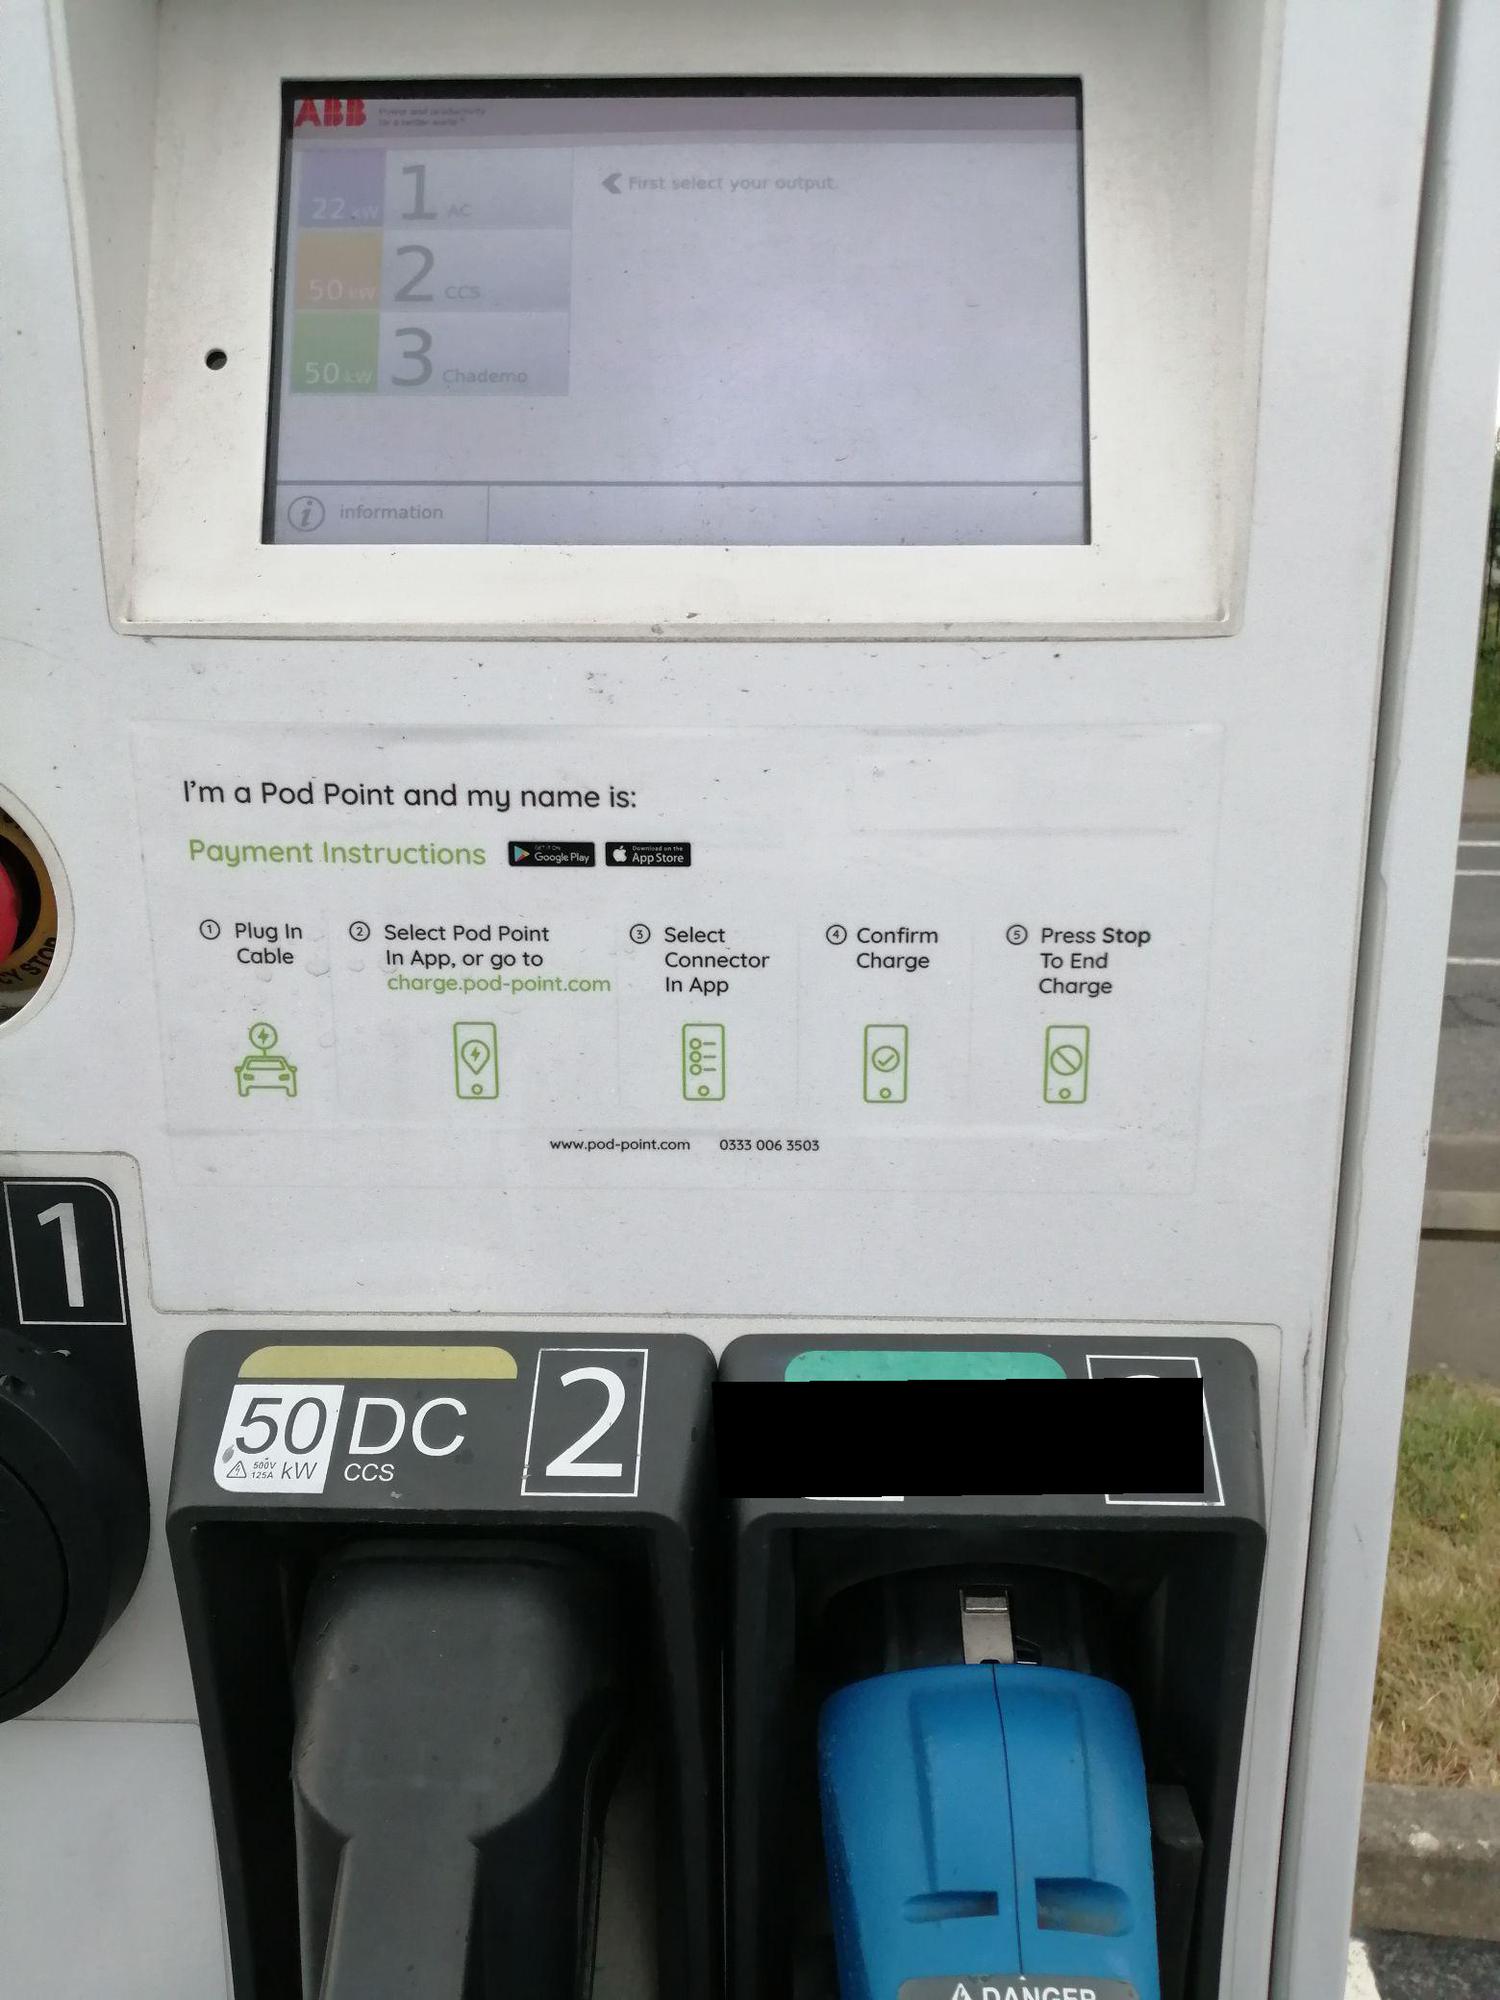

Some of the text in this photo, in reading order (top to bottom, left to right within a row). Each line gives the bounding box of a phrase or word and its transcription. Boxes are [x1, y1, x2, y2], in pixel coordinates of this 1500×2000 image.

[294, 97, 367, 127] ABB
[401, 164, 438, 222] 1
[628, 175, 666, 191] First
[672, 175, 723, 192] select
[729, 178, 768, 194] your
[311, 196, 346, 220] 22
[447, 203, 472, 218] AC
[394, 244, 435, 302] 2
[309, 279, 344, 301] 50
[444, 285, 481, 300] CCS
[391, 327, 433, 387] 3
[305, 361, 340, 385] 50
[442, 367, 528, 385] Chademo
[339, 503, 444, 521] information
[233, 786, 253, 805] a
[260, 781, 315, 806] Pod
[322, 781, 396, 807] Point
[402, 782, 458, 808] and
[466, 788, 512, 813] my
[520, 789, 601, 810] name
[608, 784, 637, 809] is:
[188, 838, 487, 868] Payment Instructions
[534, 850, 590, 865] Google Play
[632, 844, 663, 852] Download
[673, 844, 684, 852] the
[632, 851, 685, 865] App Store
[234, 921, 280, 944] Plug
[285, 922, 303, 941] In
[384, 922, 447, 942] Select
[452, 923, 492, 943] Pod
[498, 924, 551, 943] Point
[664, 925, 727, 945] Select
[855, 925, 940, 945] Confirm
[1040, 926, 1097, 945] Press
[1101, 926, 1152, 948] Stop
[20, 936, 57, 976] STOP
[235, 946, 295, 966] Cable
[385, 948, 545, 972] In App, or go to
[664, 950, 771, 970] Connector
[855, 950, 931, 973] Charge
[1039, 951, 1110, 970] To End
[386, 974, 612, 995] charge.pod-point.com
[664, 975, 730, 997] In App
[1037, 976, 1114, 1000] Charge
[549, 1137, 692, 1154] www.pod-point.com
[718, 1137, 821, 1152] 0333 006 3503
[37, 1202, 84, 1308] 1
[235, 1396, 328, 1455] 50
[348, 1397, 467, 1457] DC
[545, 1366, 627, 1478] 2
[251, 1470, 275, 1480] 125A
[252, 1461, 277, 1471] 500V
[280, 1460, 319, 1481] kW
[343, 1462, 395, 1483] CCS
[981, 1985, 1097, 2000] DANGER
